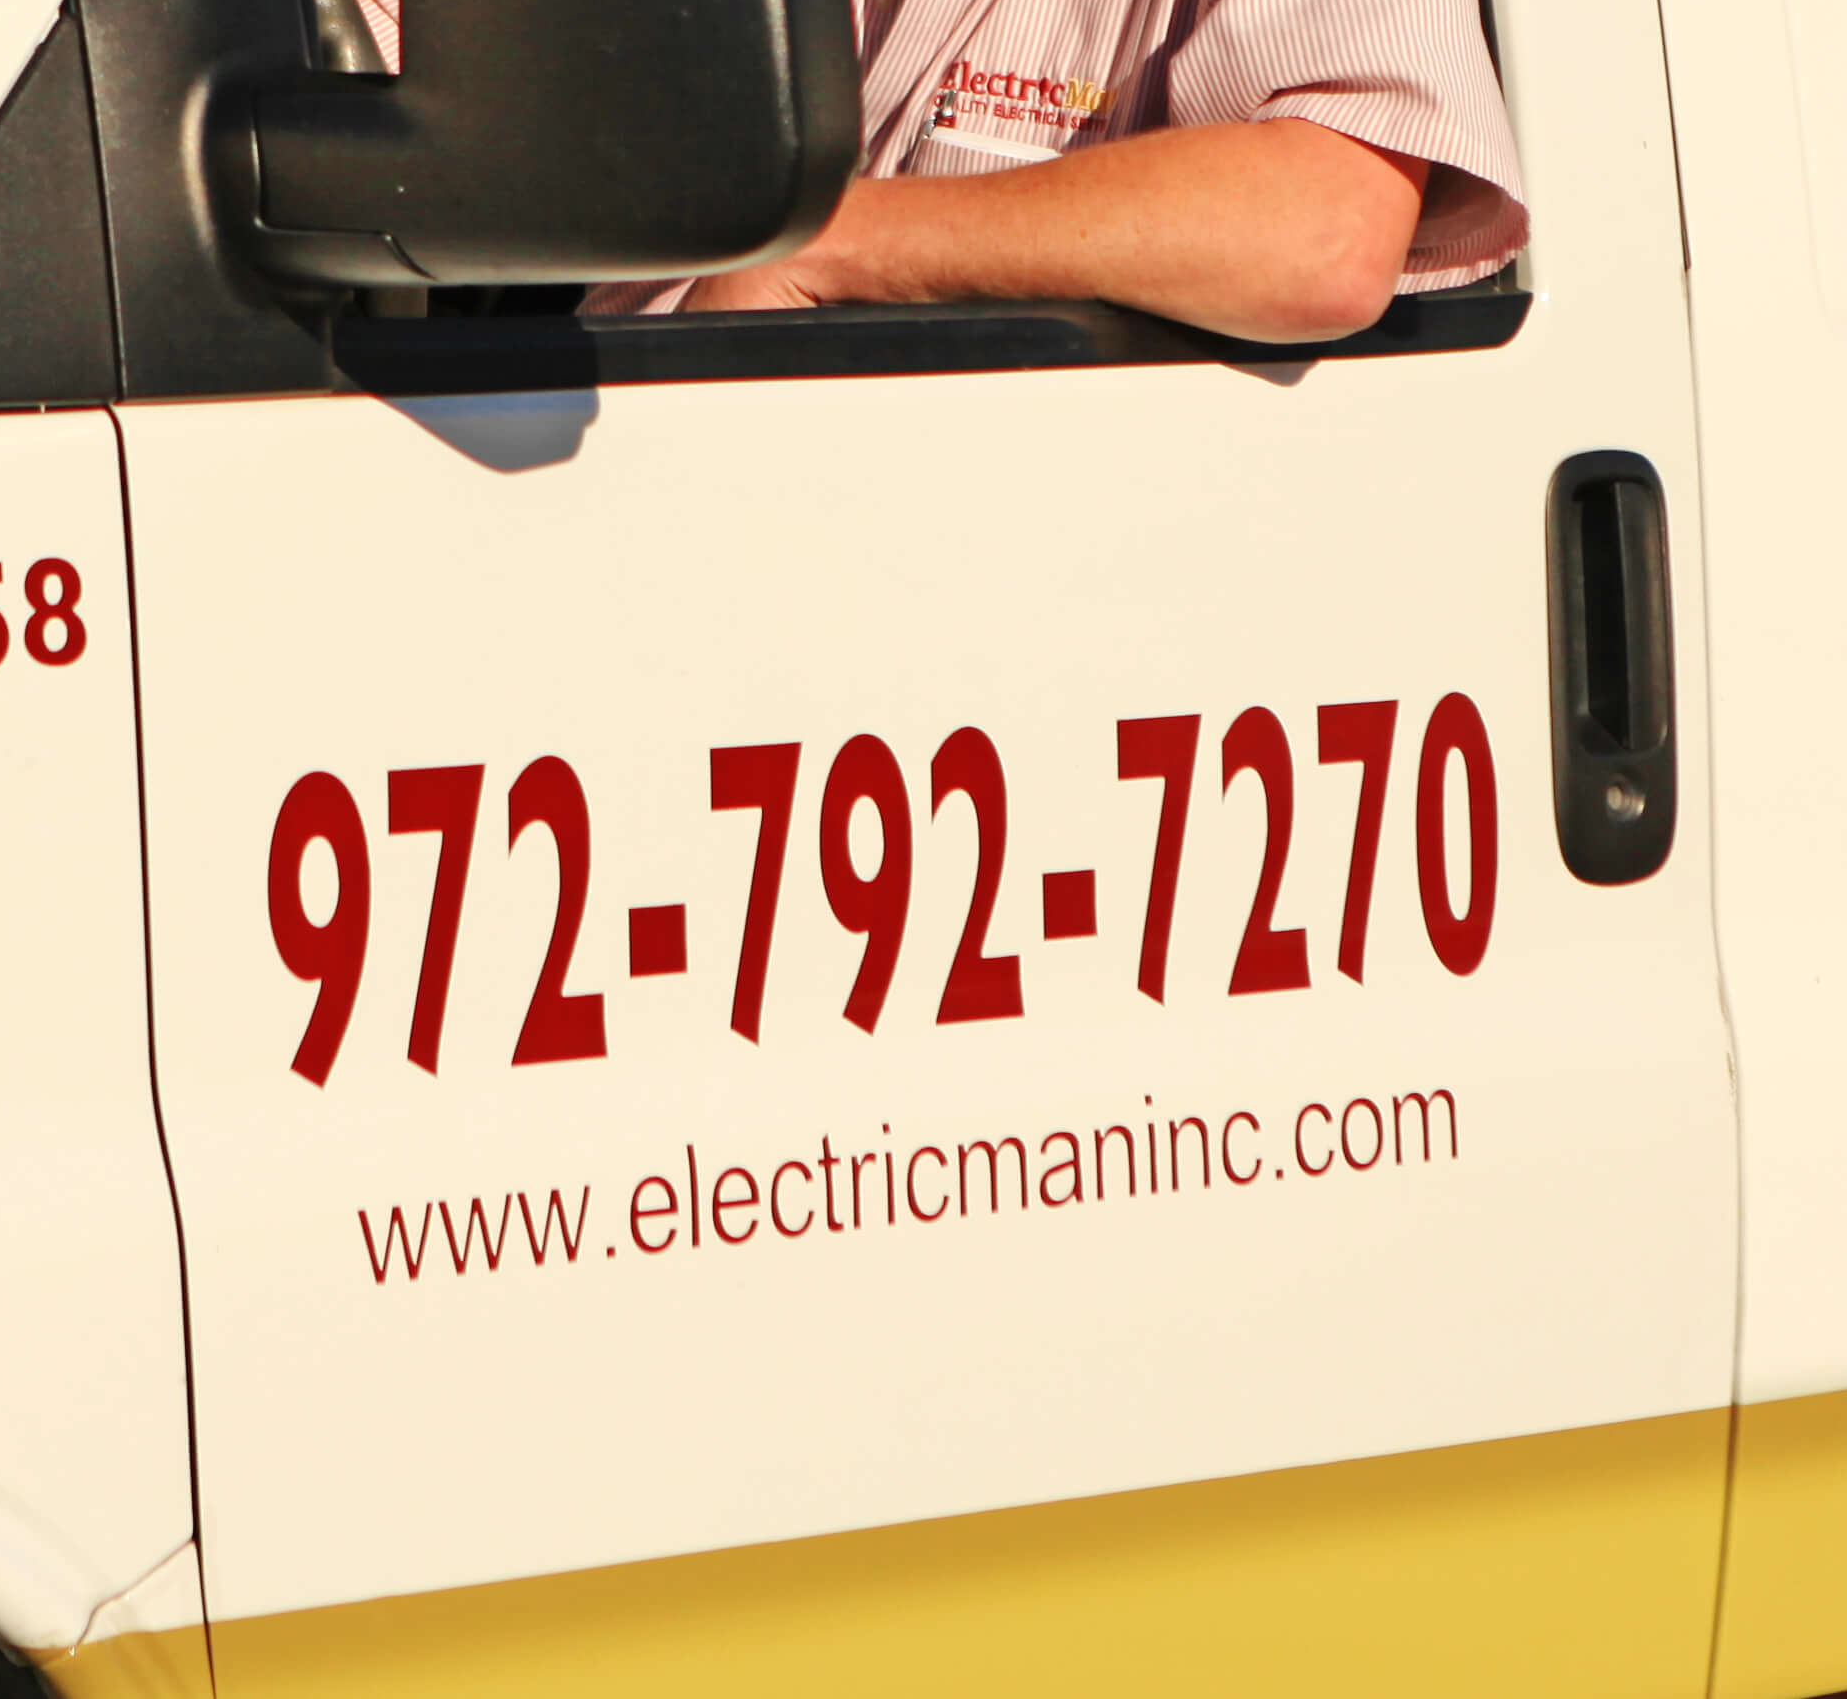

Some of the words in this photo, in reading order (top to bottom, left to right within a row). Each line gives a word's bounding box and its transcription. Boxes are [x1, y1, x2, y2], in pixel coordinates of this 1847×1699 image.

[993, 103, 1065, 129] ELECTRICAL
[267, 691, 1500, 1089] 972-792-7270
[357, 1087, 1461, 1285] www.electricmaninc.com
